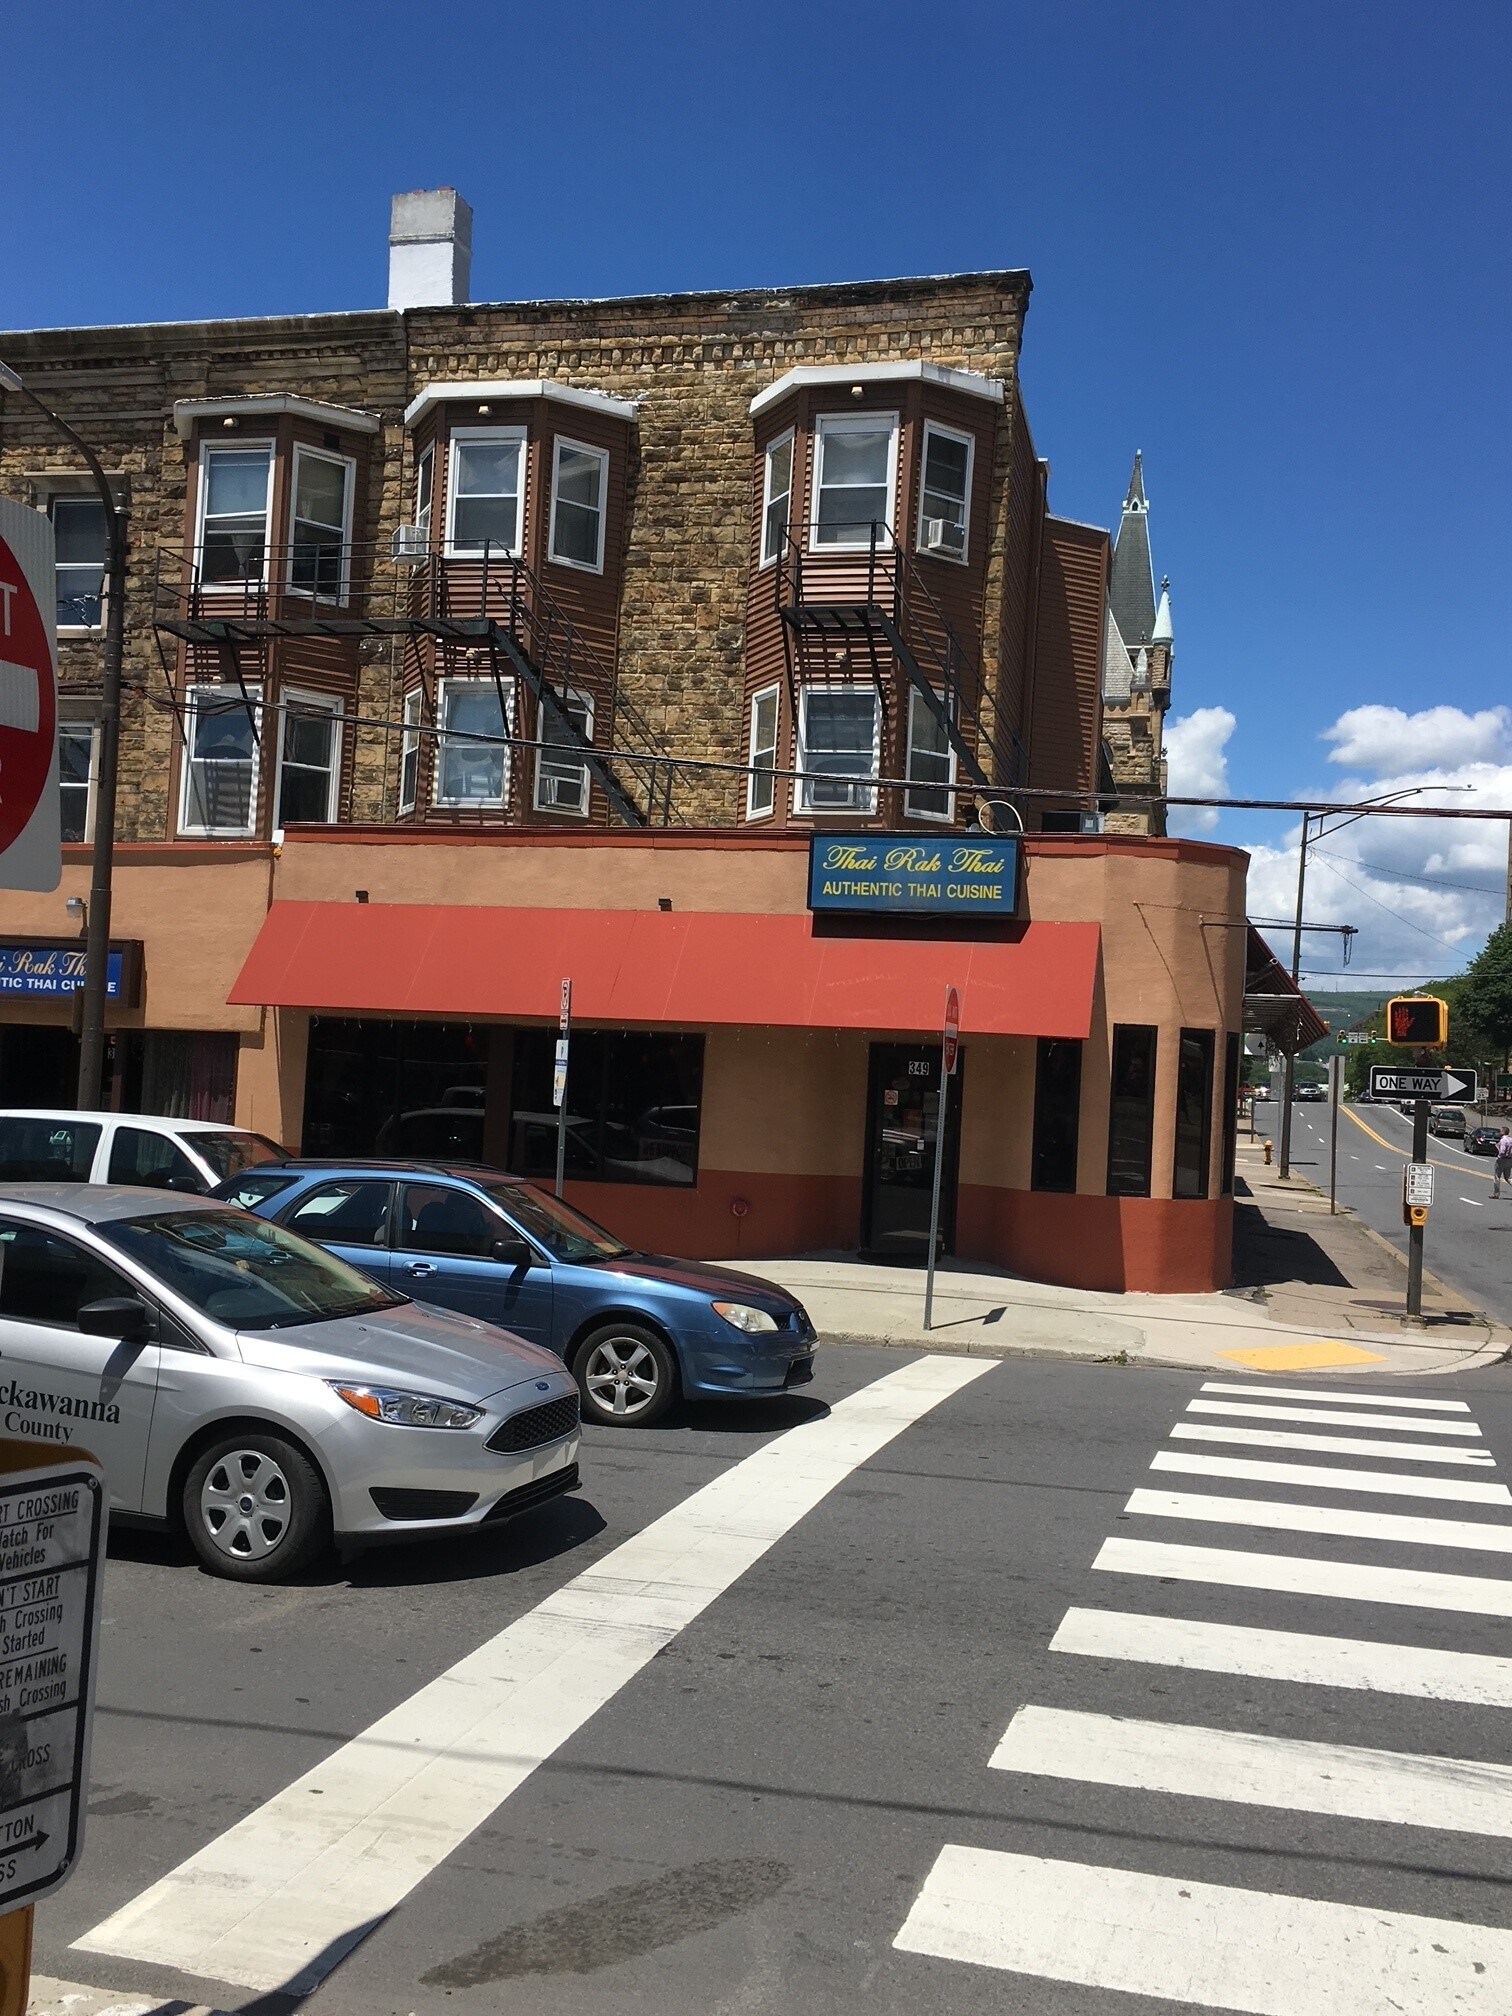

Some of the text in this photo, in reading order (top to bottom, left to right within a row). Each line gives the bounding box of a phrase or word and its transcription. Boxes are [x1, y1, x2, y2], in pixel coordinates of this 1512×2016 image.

[823, 845, 1005, 873] Thai Rak Thai
[822, 881, 1002, 899] AUTHENTIC THAI CUISINE
[8, 950, 57, 975] Rak
[1, 977, 22, 988] TIC
[26, 978, 57, 989] THAI
[909, 1062, 929, 1075] 349
[1379, 1076, 1440, 1091] ONE WAY
[0, 1380, 120, 1424] ckawanna
[5, 1411, 73, 1445] County
[17, 1490, 79, 1520] CROSSING
[36, 1522, 54, 1541] For
[23, 1575, 60, 1602] START
[15, 1602, 63, 1630] Crossing
[2, 1626, 45, 1655] Started
[20, 1679, 67, 1708] Crossing
